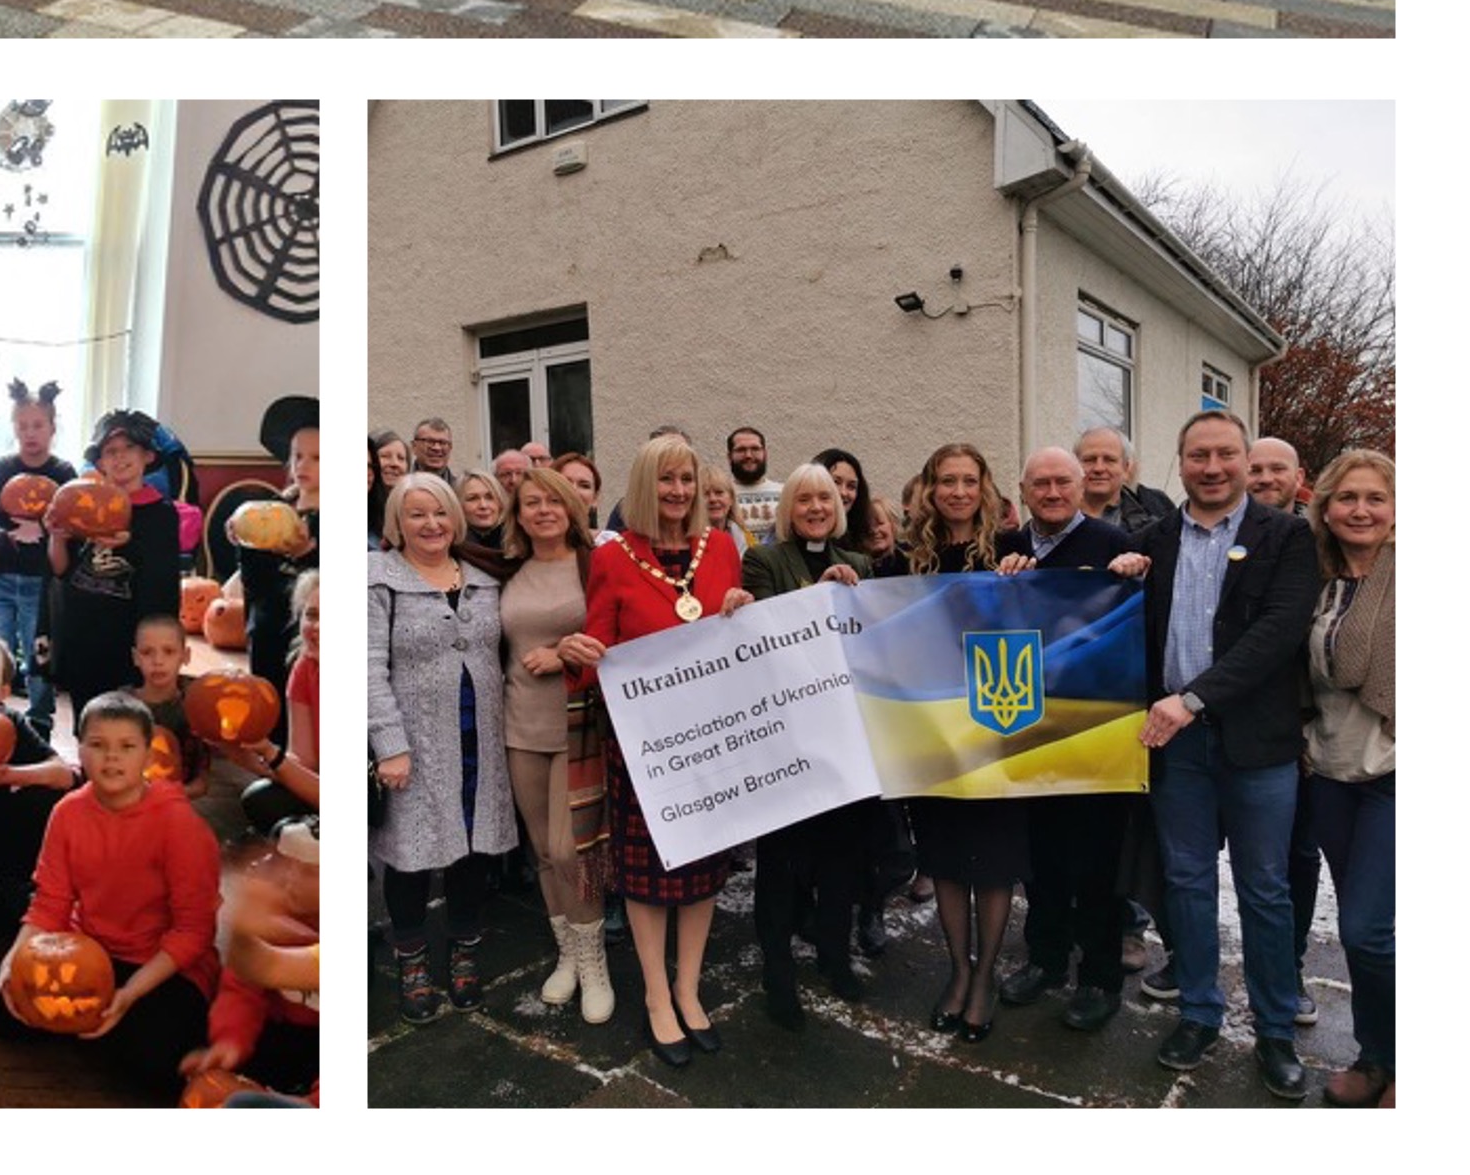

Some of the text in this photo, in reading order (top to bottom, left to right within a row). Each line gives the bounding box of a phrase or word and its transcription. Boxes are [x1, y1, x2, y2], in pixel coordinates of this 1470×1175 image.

[621, 654, 731, 700] Ukrainian
[734, 621, 821, 663] Cultural
[640, 673, 854, 756] Association of Ukrainia
[647, 719, 785, 780] in Great Britain
[660, 757, 811, 822] Glasgow Branch
